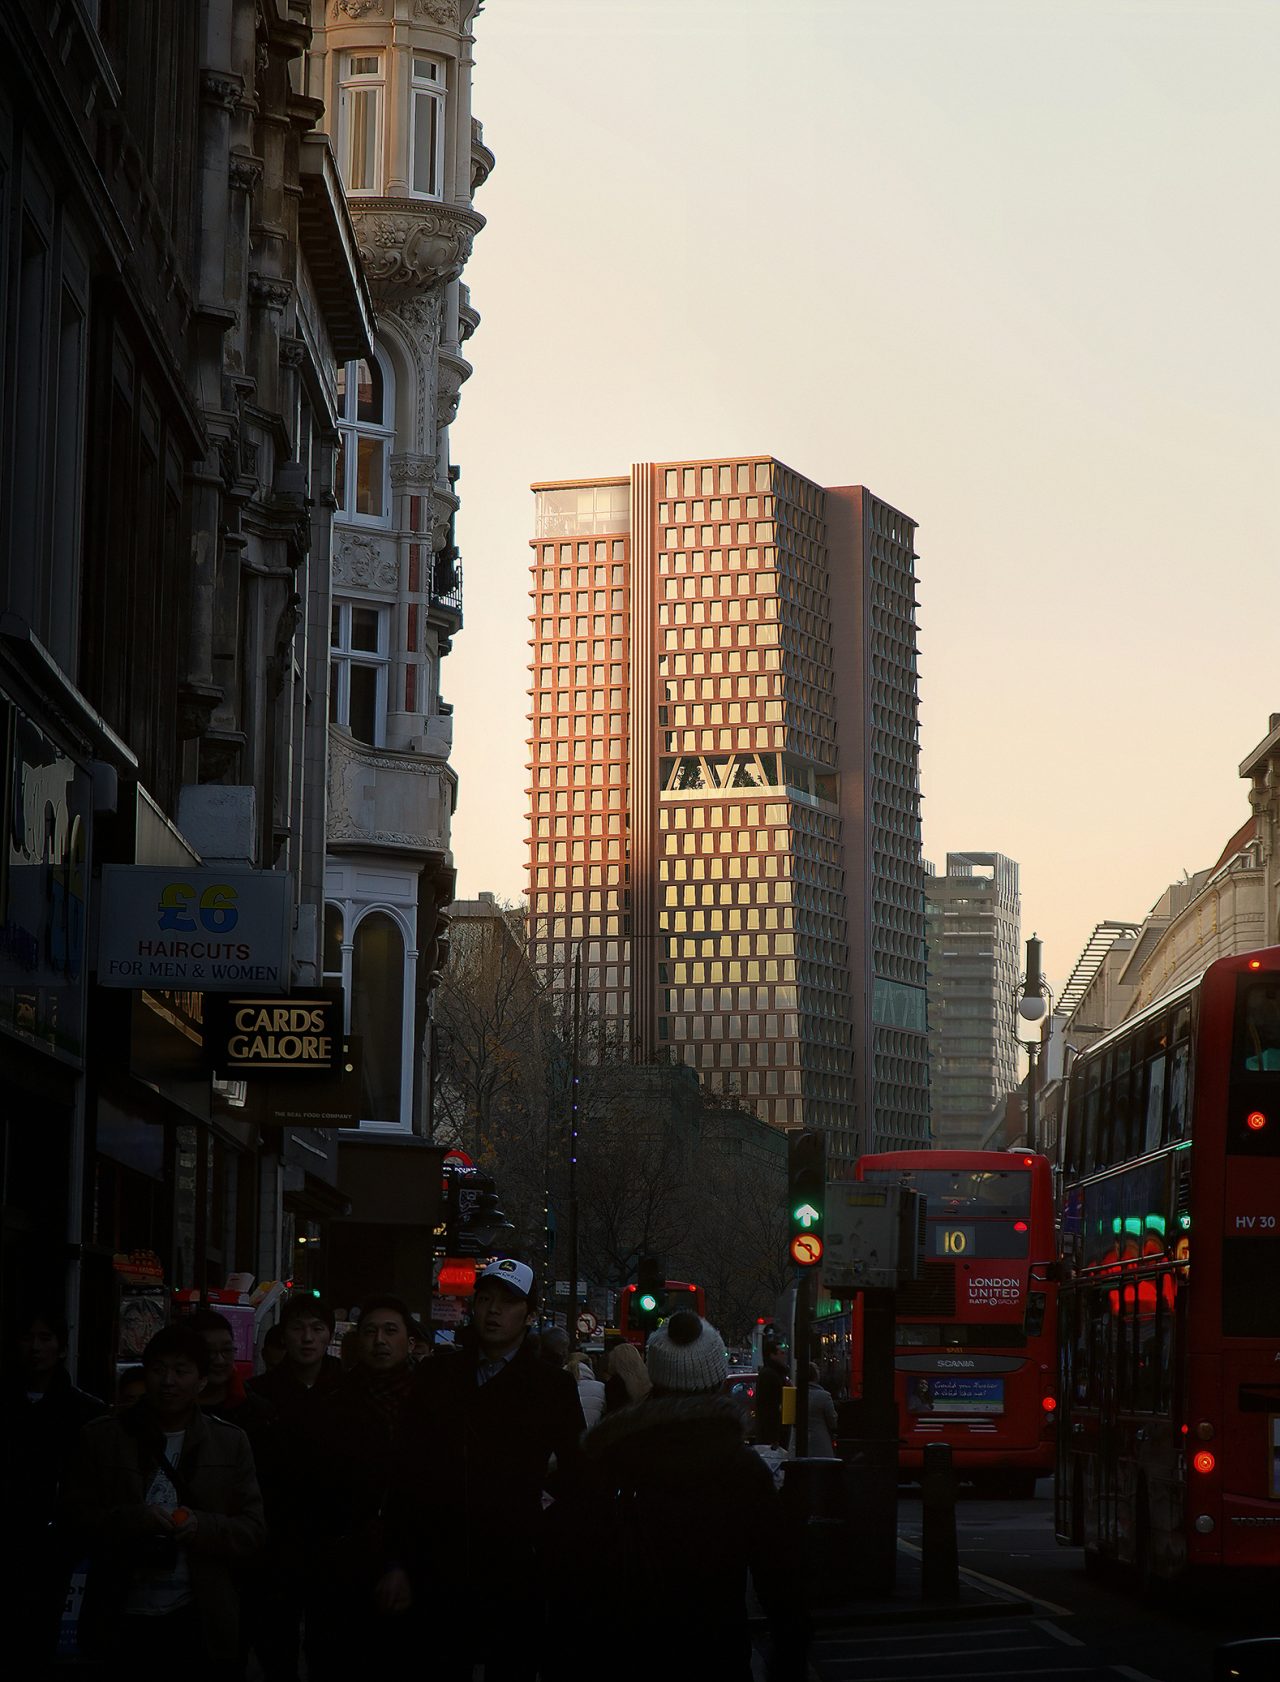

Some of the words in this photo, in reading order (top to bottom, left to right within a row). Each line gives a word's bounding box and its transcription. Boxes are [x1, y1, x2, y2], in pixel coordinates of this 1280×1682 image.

[157, 882, 239, 934] £6
[138, 940, 250, 961] HAIRCUTS
[109, 960, 143, 976] FOR
[149, 962, 187, 978] MEN
[191, 965, 205, 979] &
[212, 964, 278, 981] WOMEN
[234, 1008, 325, 1033] CARDS
[227, 1035, 332, 1060] GALORE
[321, 1112, 353, 1120] COMPANY
[1236, 1216, 1256, 1229] HV
[1259, 1216, 1276, 1229] 30
[943, 1230, 967, 1253] 10
[969, 1278, 1020, 1287] LONDON
[969, 1288, 1020, 1298] UNITED
[937, 1359, 976, 1368] SCANIA
